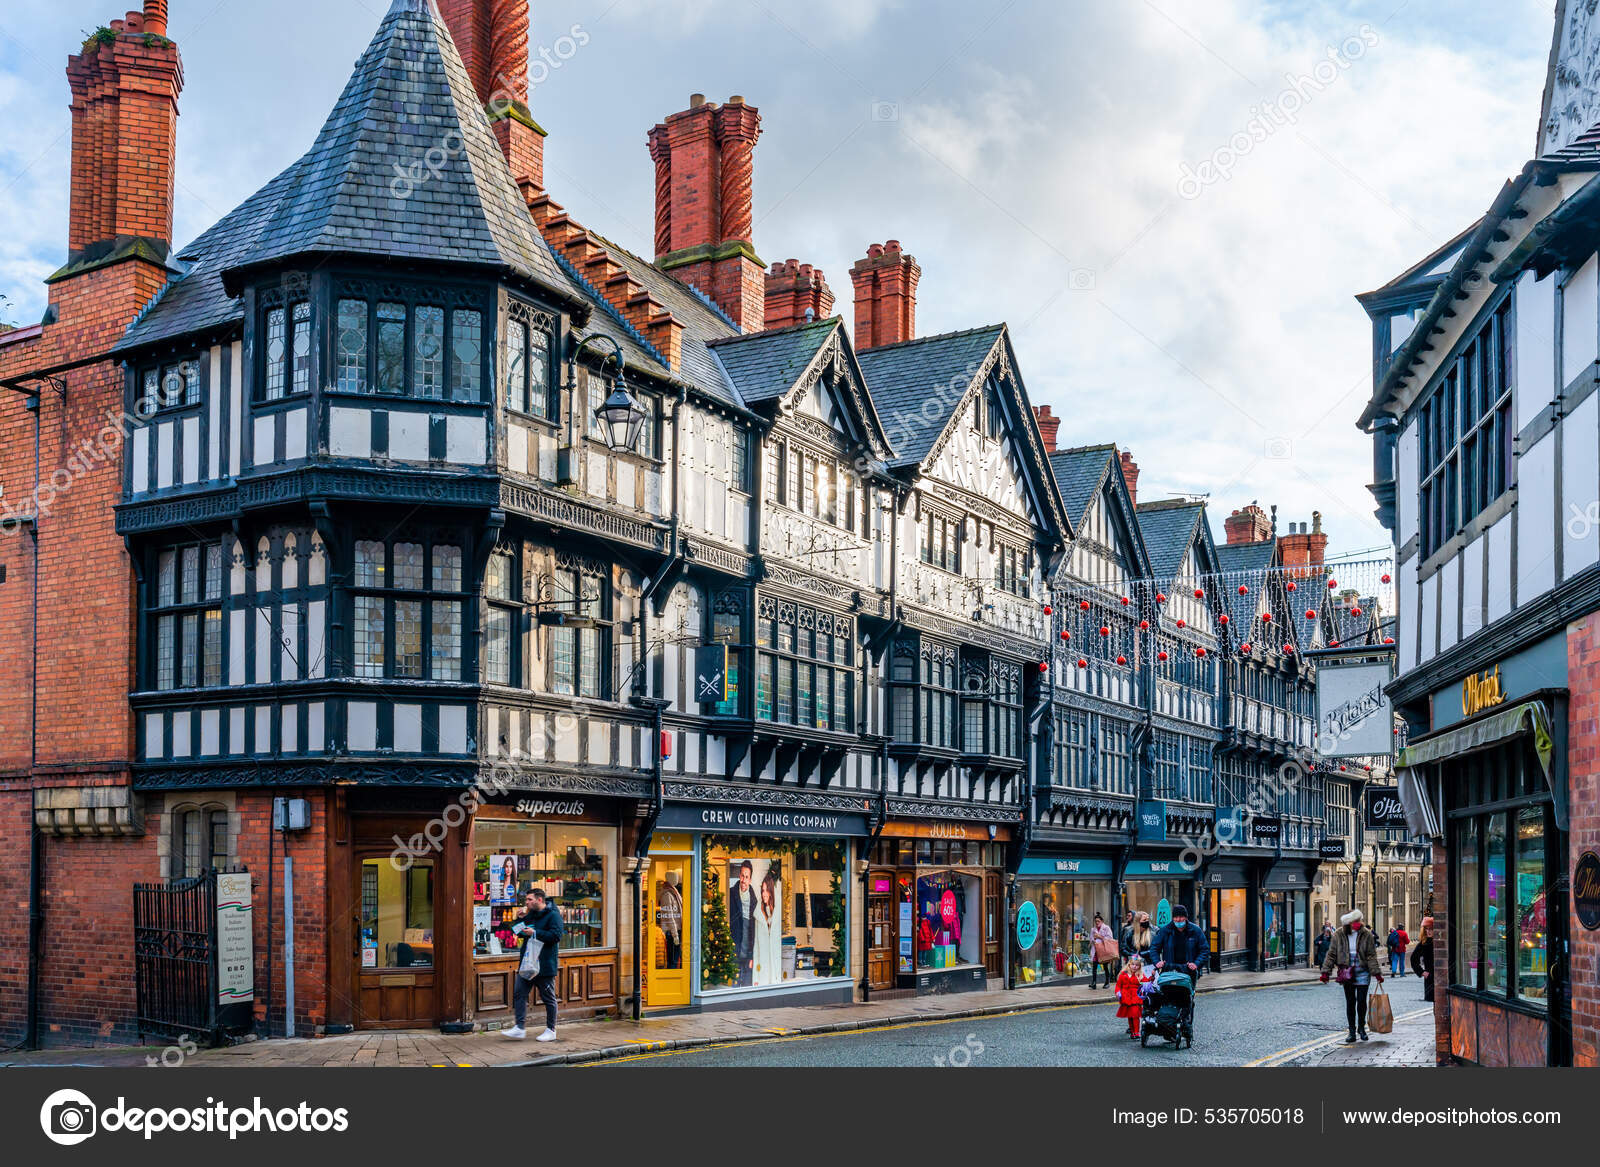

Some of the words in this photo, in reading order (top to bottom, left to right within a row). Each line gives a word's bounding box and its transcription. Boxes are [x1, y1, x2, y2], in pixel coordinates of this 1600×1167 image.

[516, 799, 585, 817] supercuts
[702, 810, 733, 823] CREW
[737, 813, 789, 826] CLOTHING
[793, 815, 838, 829] COMPANY
[930, 823, 966, 838] JOULES
